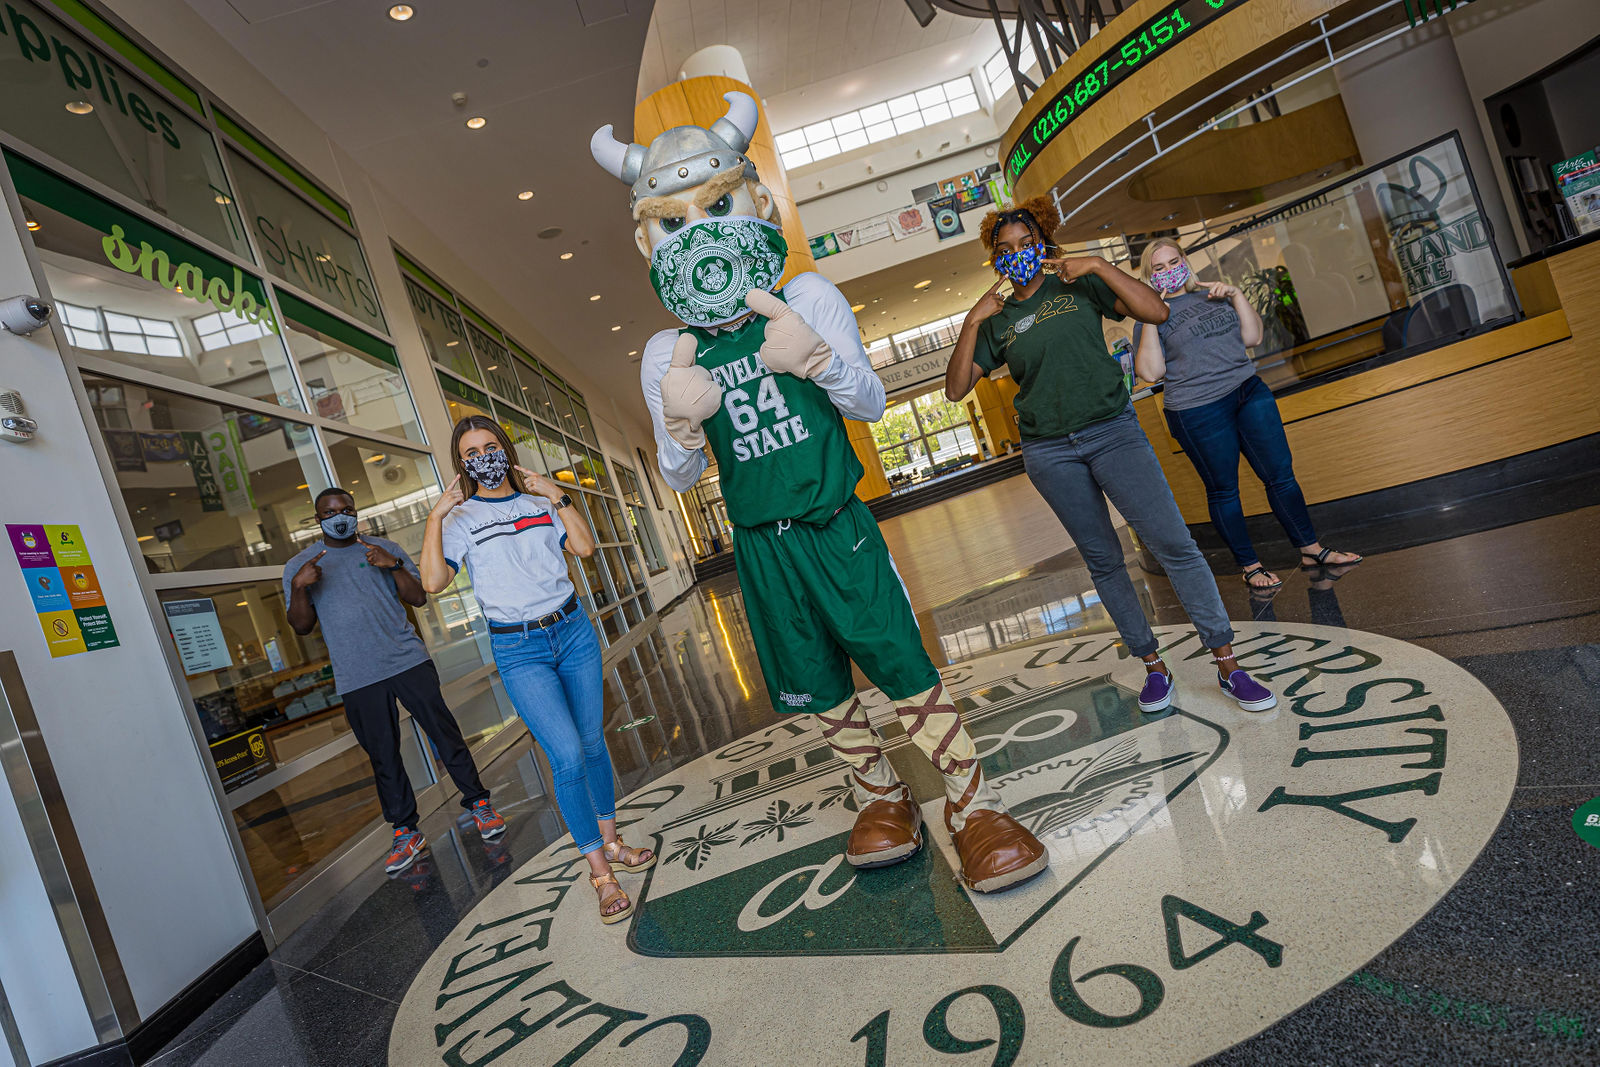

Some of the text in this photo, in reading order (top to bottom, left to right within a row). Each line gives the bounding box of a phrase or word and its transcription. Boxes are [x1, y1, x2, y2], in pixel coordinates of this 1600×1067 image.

[0, 3, 181, 150] pplies
[1011, 8, 1191, 176] CALL (216)687-5151
[1398, 214, 1489, 272] LAND
[913, 359, 940, 374] TOM
[724, 374, 790, 434] 64
[732, 414, 810, 463] STATE
[850, 894, 1285, 1067] 1964
